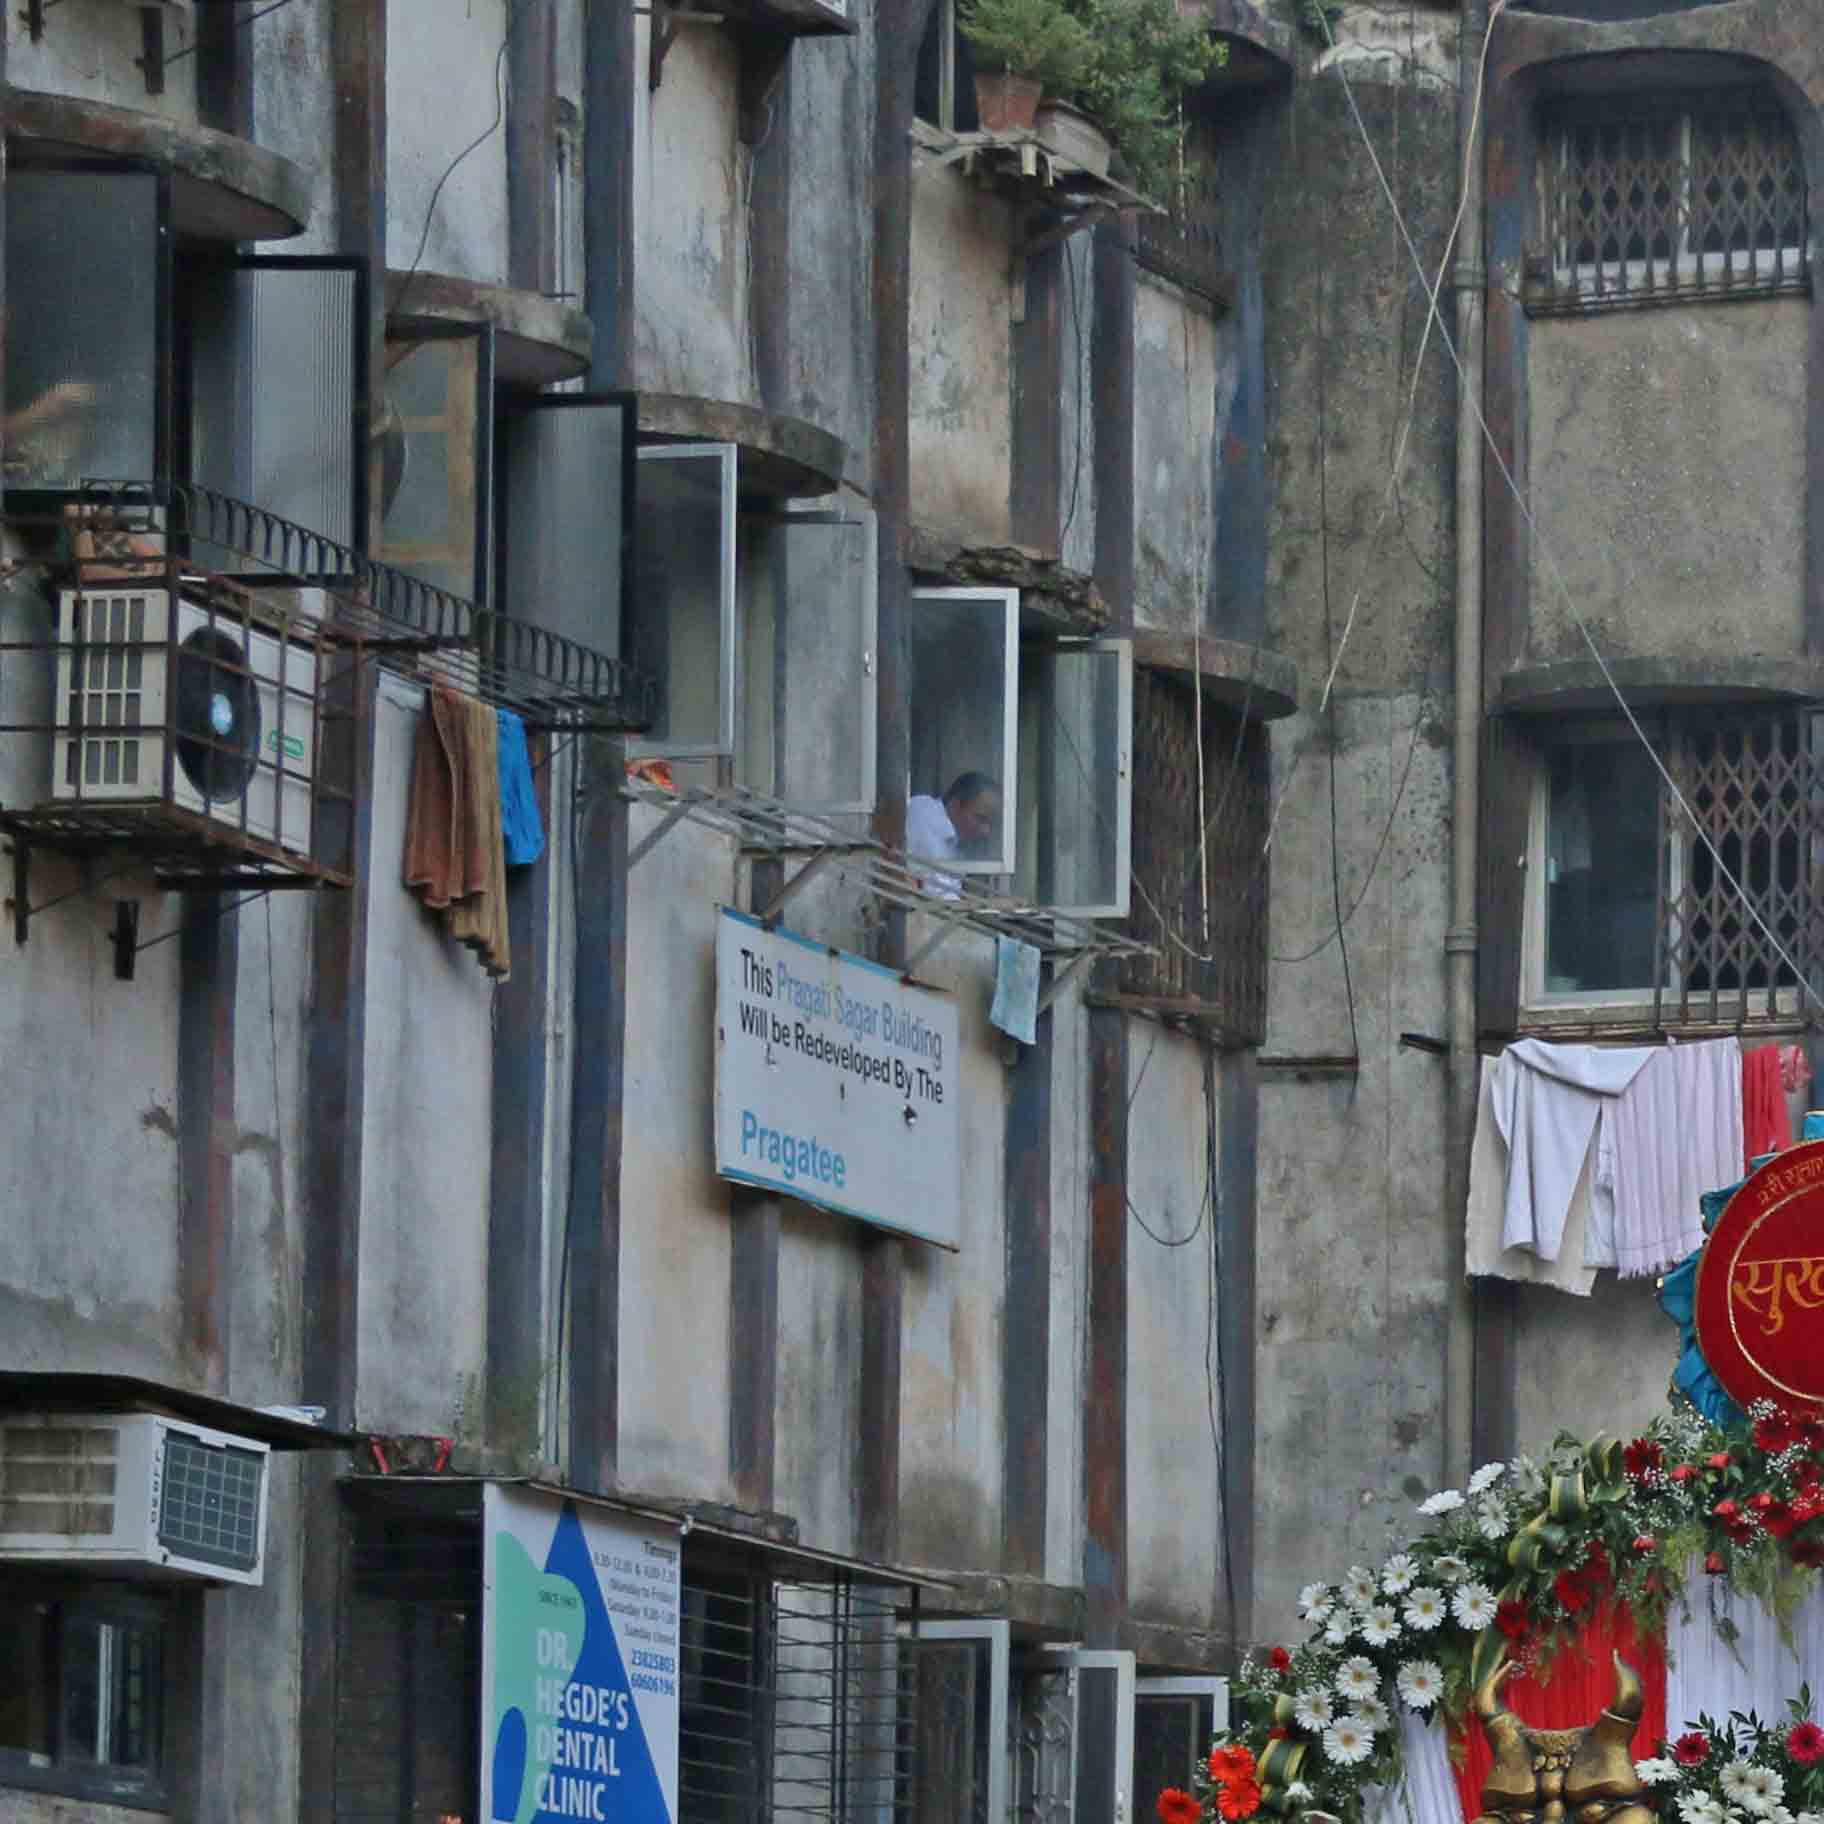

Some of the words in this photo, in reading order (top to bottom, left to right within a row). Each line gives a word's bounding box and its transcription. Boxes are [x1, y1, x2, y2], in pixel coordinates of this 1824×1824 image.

[740, 948, 773, 998] This
[834, 984, 879, 1043] Sagar
[881, 1001, 942, 1071] Building
[739, 1000, 768, 1041] Will
[771, 1013, 791, 1047] be
[794, 1022, 890, 1085] Redeveloped
[895, 1059, 913, 1099] By
[916, 1067, 943, 1104] The
[741, 1110, 847, 1188] Pragatee
[536, 1630, 574, 1671] DR.
[536, 1677, 630, 1731] HEGDE'S
[536, 1725, 621, 1777] DENTAL
[534, 1771, 607, 1822] CLINIC
